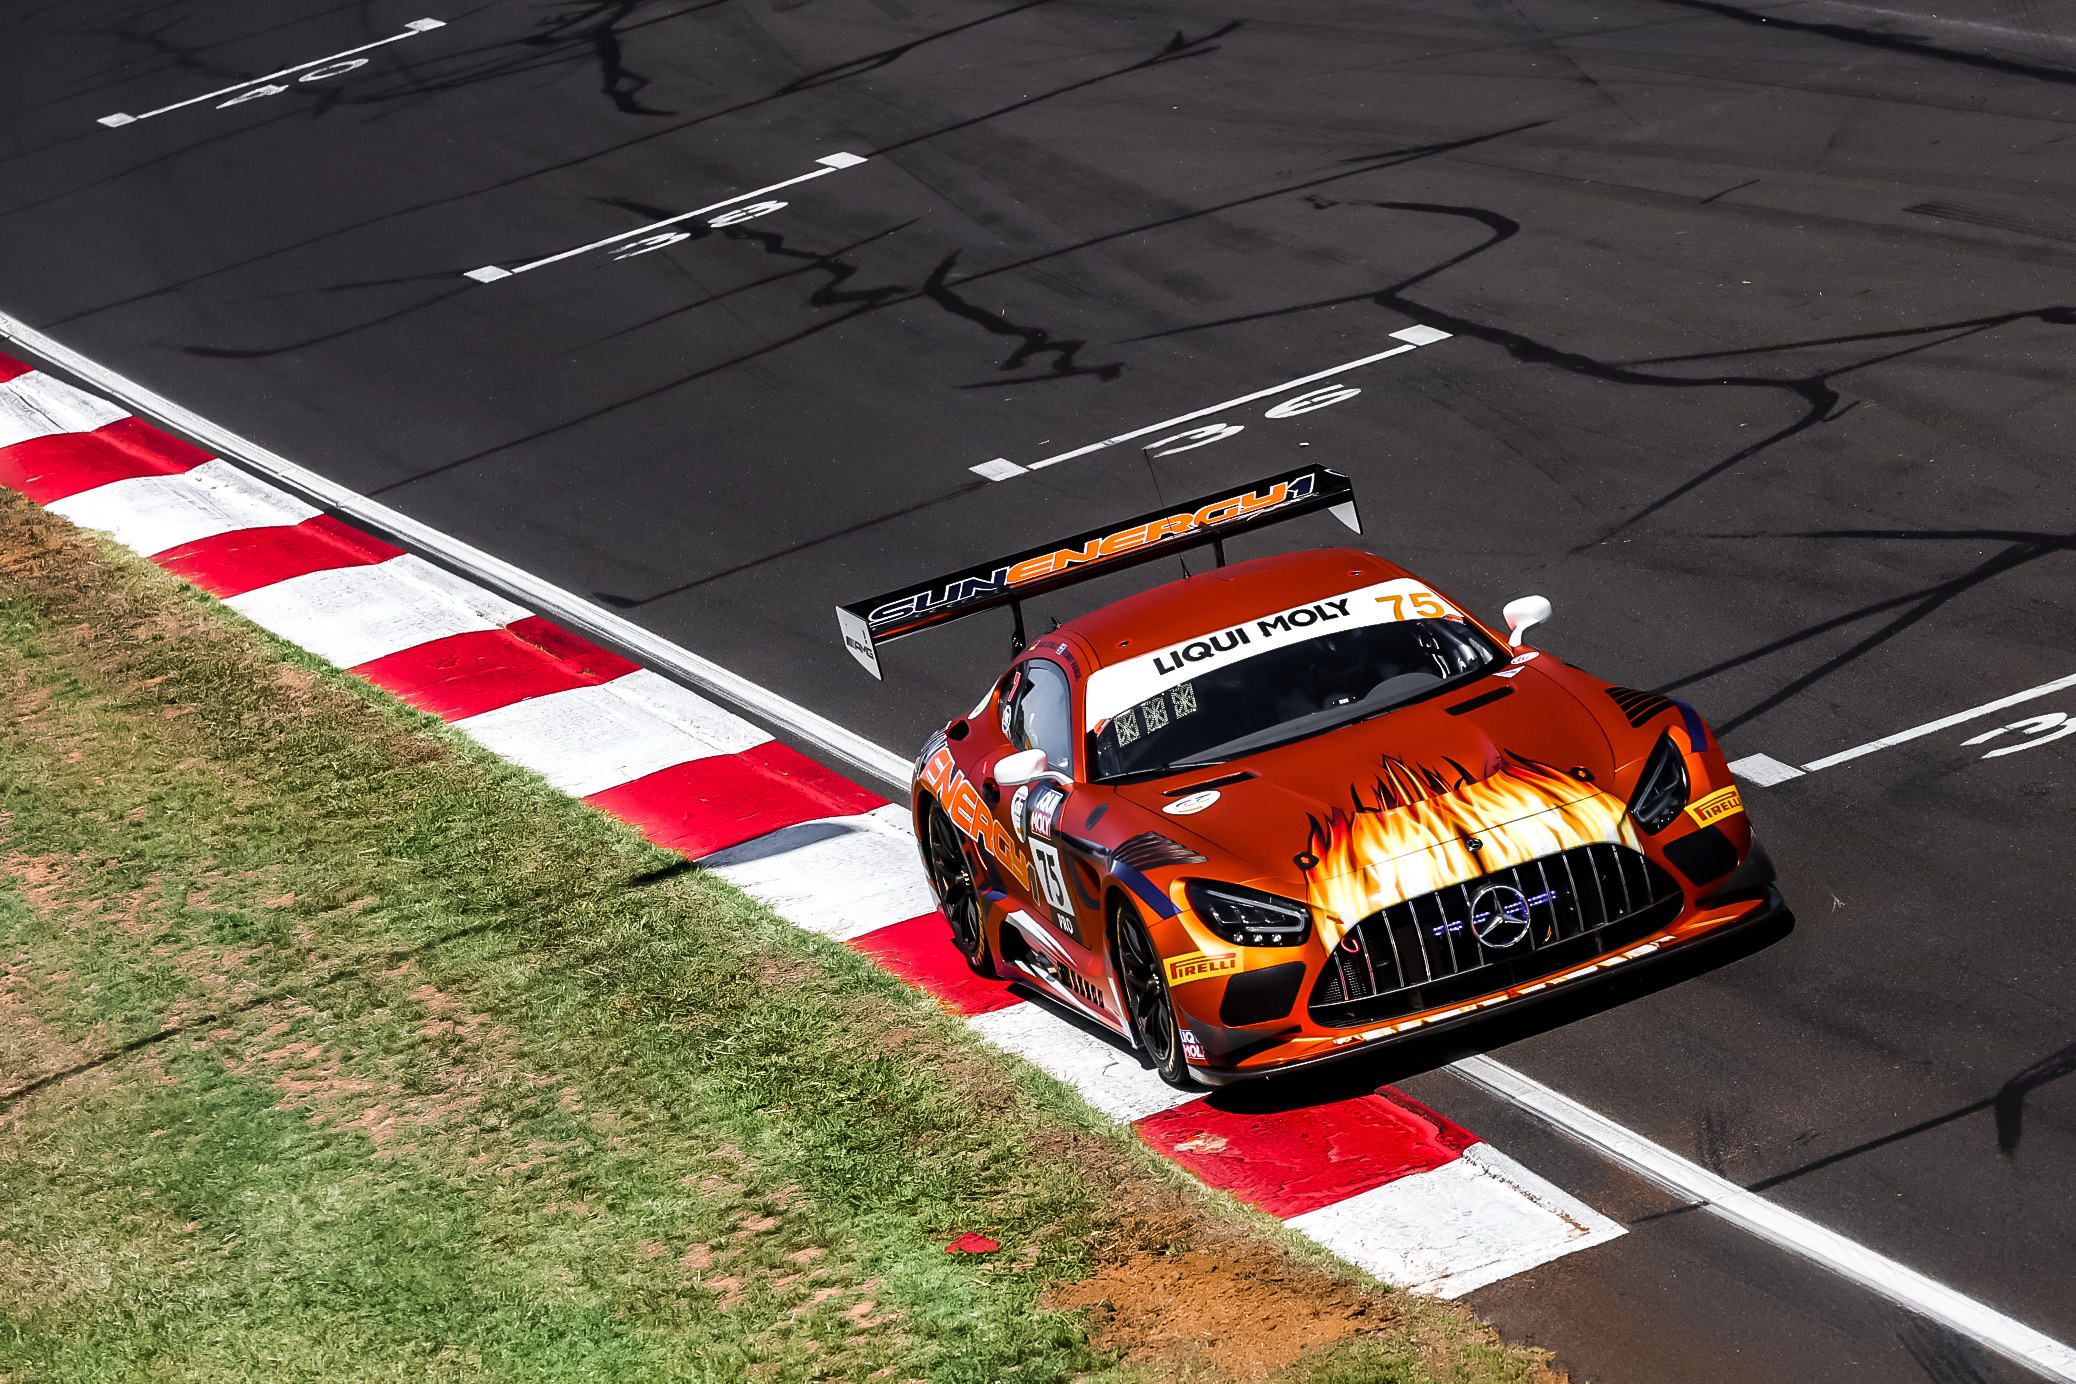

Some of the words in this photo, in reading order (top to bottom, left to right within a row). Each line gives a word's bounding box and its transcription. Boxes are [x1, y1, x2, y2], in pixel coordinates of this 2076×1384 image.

[216, 59, 369, 109] 40
[606, 200, 789, 261] 38
[1142, 384, 1361, 458] 36
[868, 472, 1316, 622] SUNENERGY1
[1153, 628, 1251, 675] LIQUI
[1257, 598, 1351, 637] MOLY
[1375, 592, 1445, 621] 75
[1036, 848, 1064, 907] 75
[1170, 953, 1236, 979] PIRELLI
